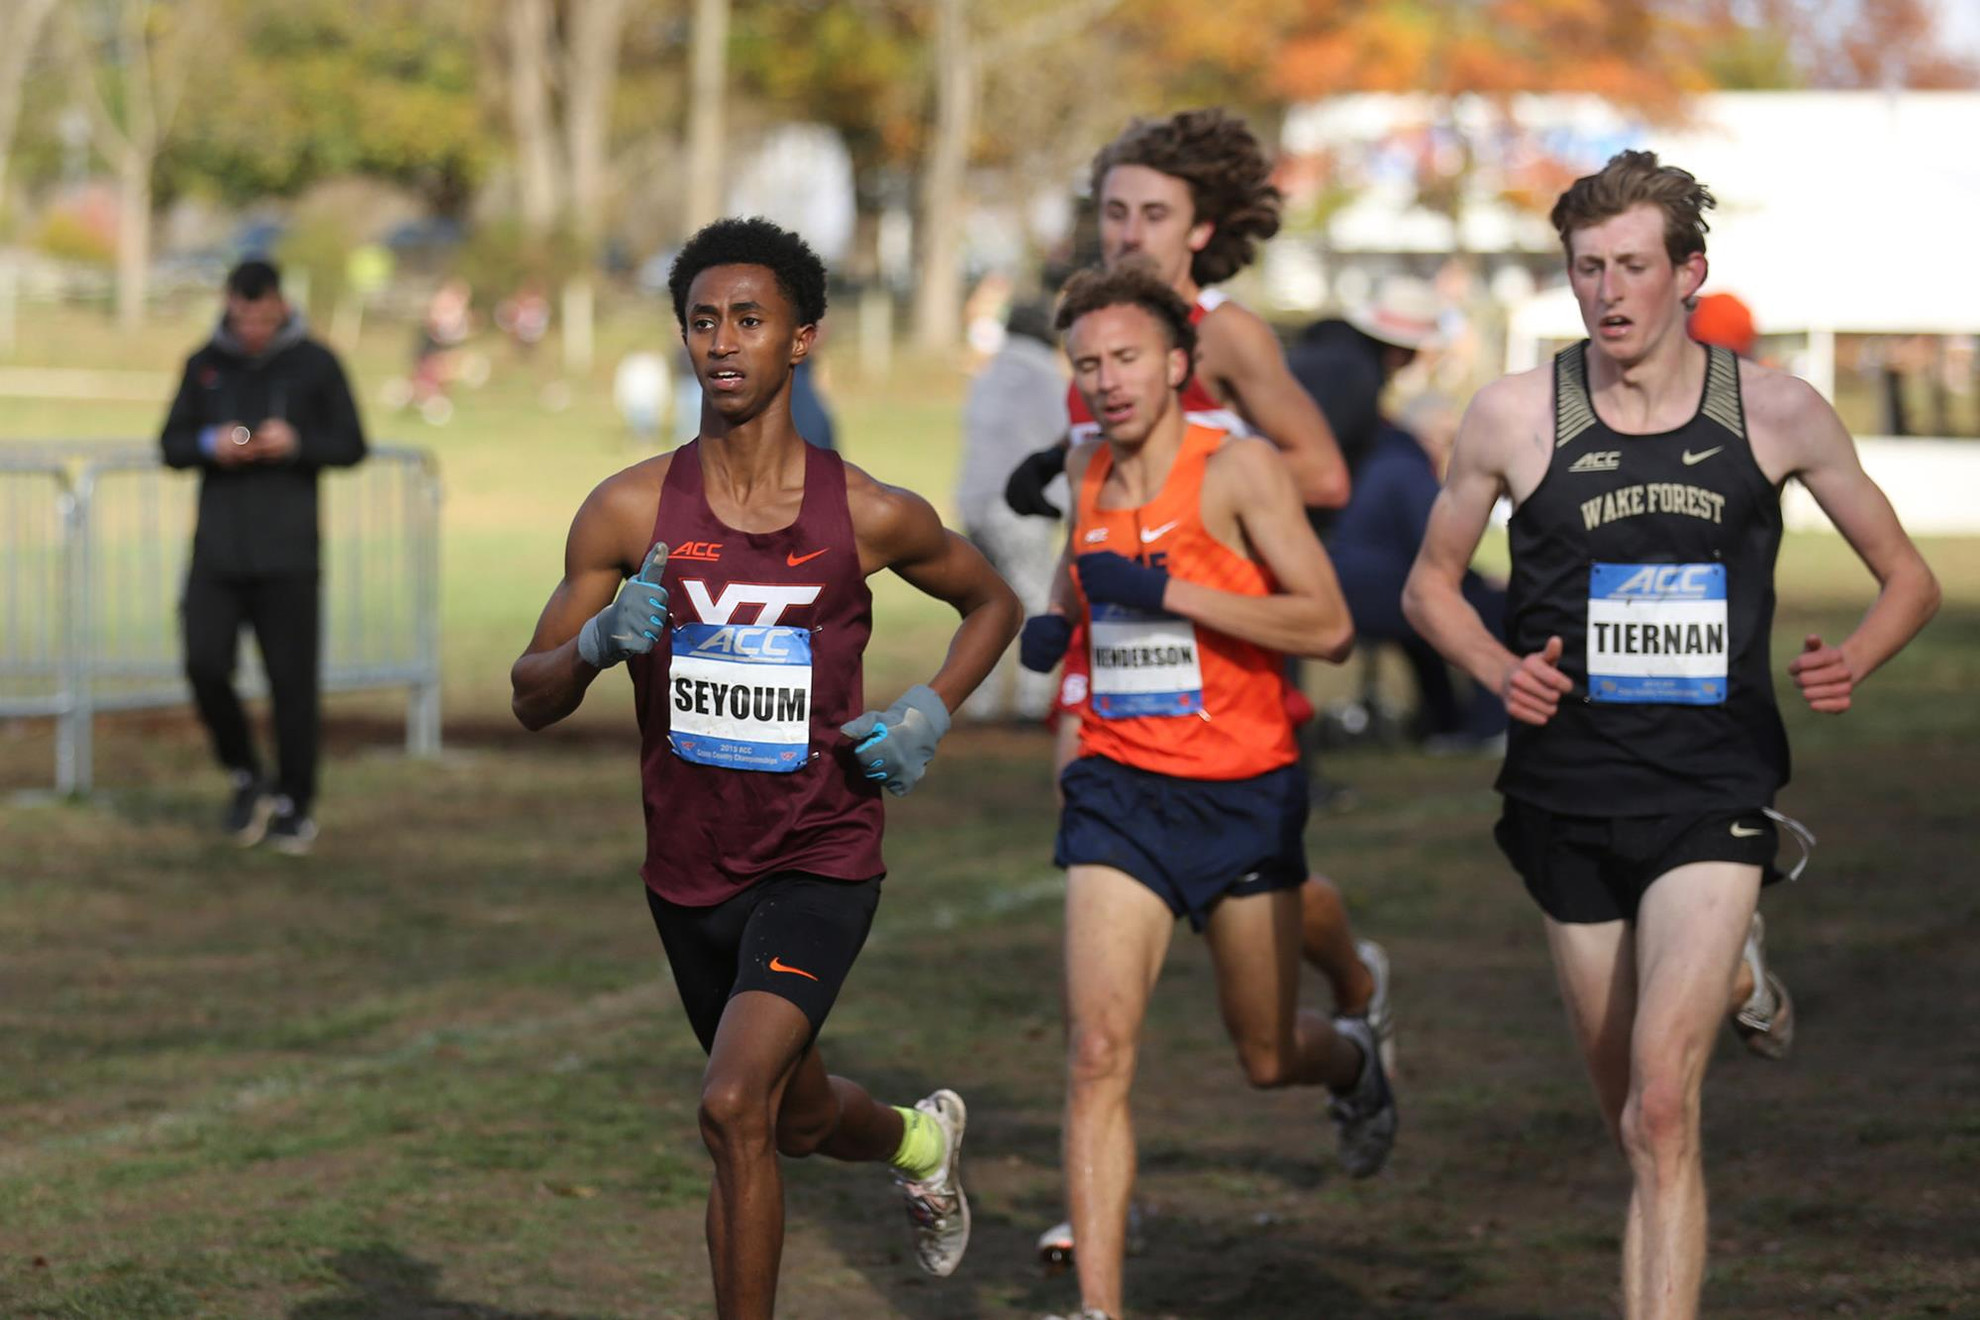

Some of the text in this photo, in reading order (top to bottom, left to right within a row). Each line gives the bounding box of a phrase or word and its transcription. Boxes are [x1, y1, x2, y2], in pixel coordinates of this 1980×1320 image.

[1572, 451, 1622, 470] ACC
[1580, 483, 1726, 531] WAKE FOREST
[670, 541, 723, 559] ACC
[1612, 565, 1713, 597] ACC
[695, 627, 794, 659] ACC
[1593, 622, 1723, 655] TIERNAN
[674, 677, 807, 722] SEYOUM
